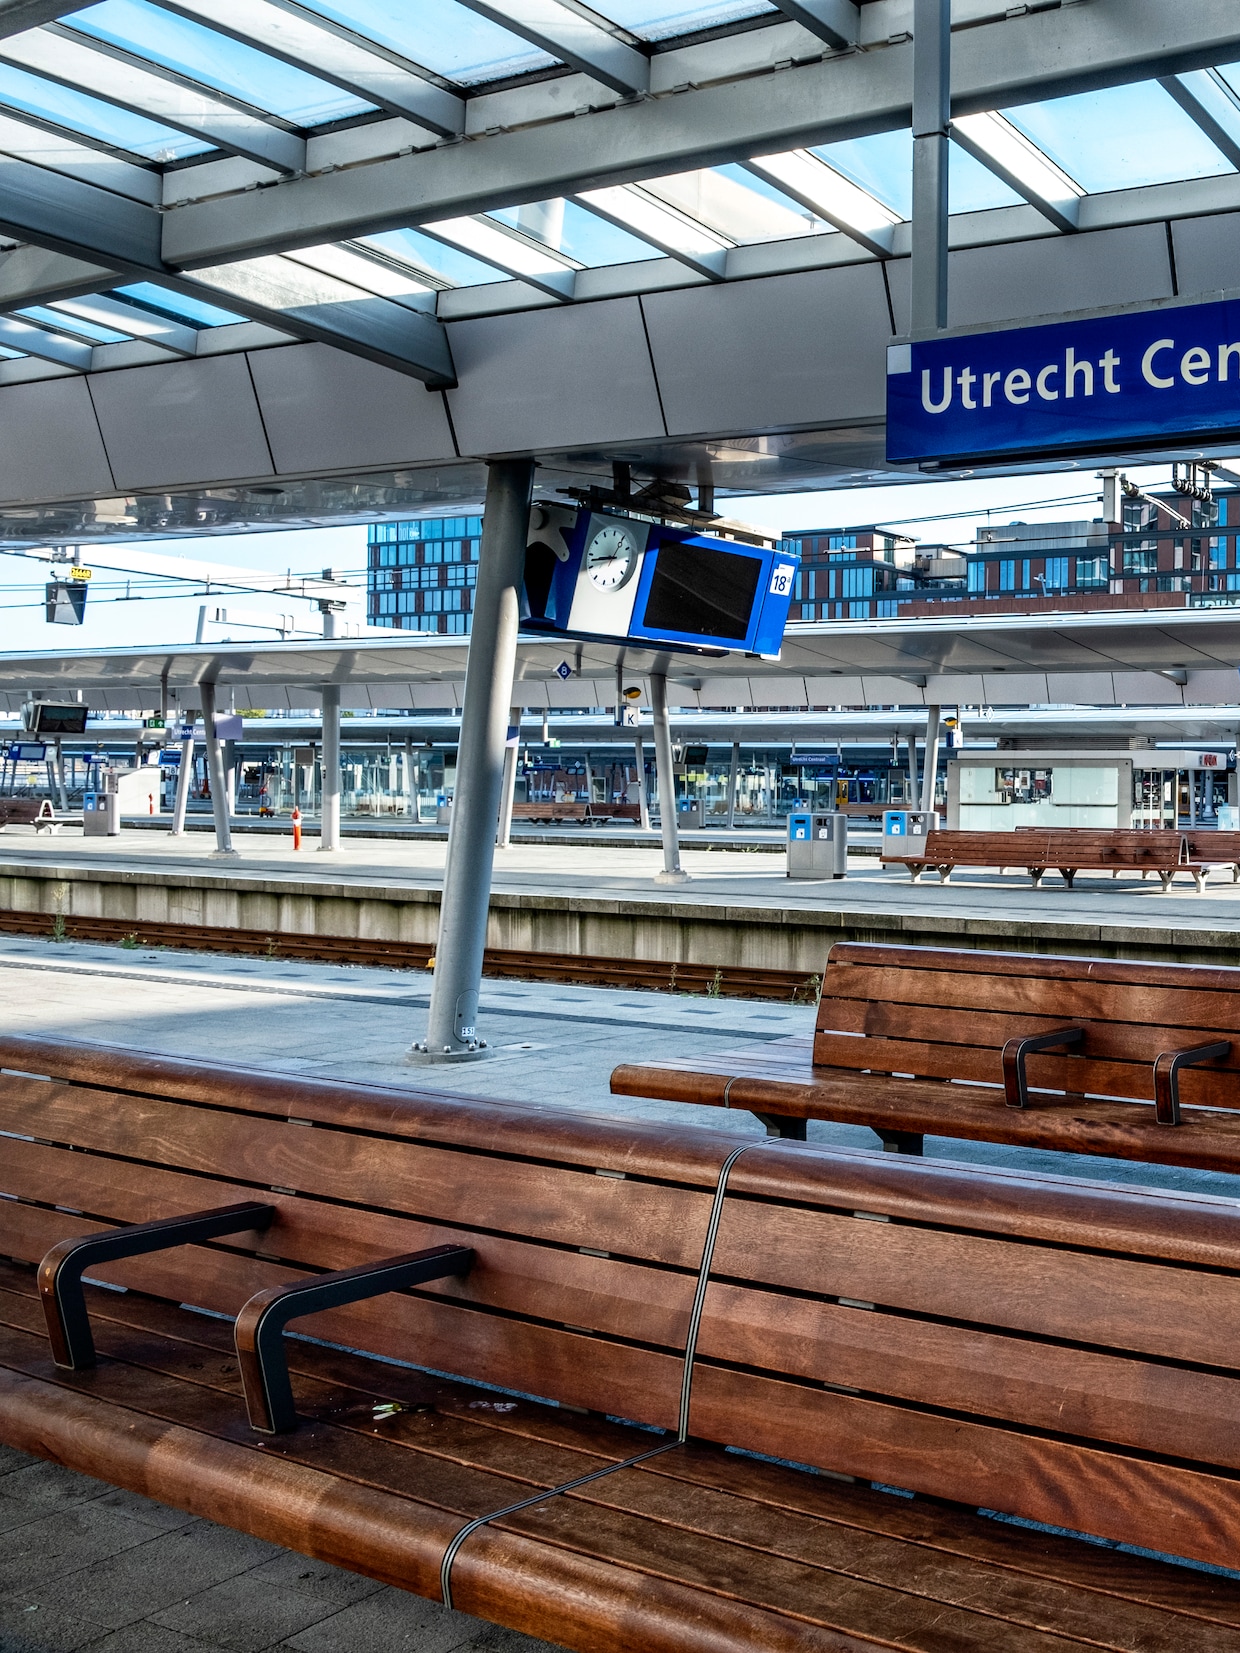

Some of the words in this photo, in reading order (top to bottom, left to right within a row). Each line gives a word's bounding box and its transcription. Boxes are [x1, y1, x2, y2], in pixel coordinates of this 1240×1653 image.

[921, 346, 1121, 414] Utrecht
[774, 574, 787, 592] 18
[560, 666, 568, 676] 8
[627, 713, 635, 726] K
[174, 728, 192, 736] Utrecht
